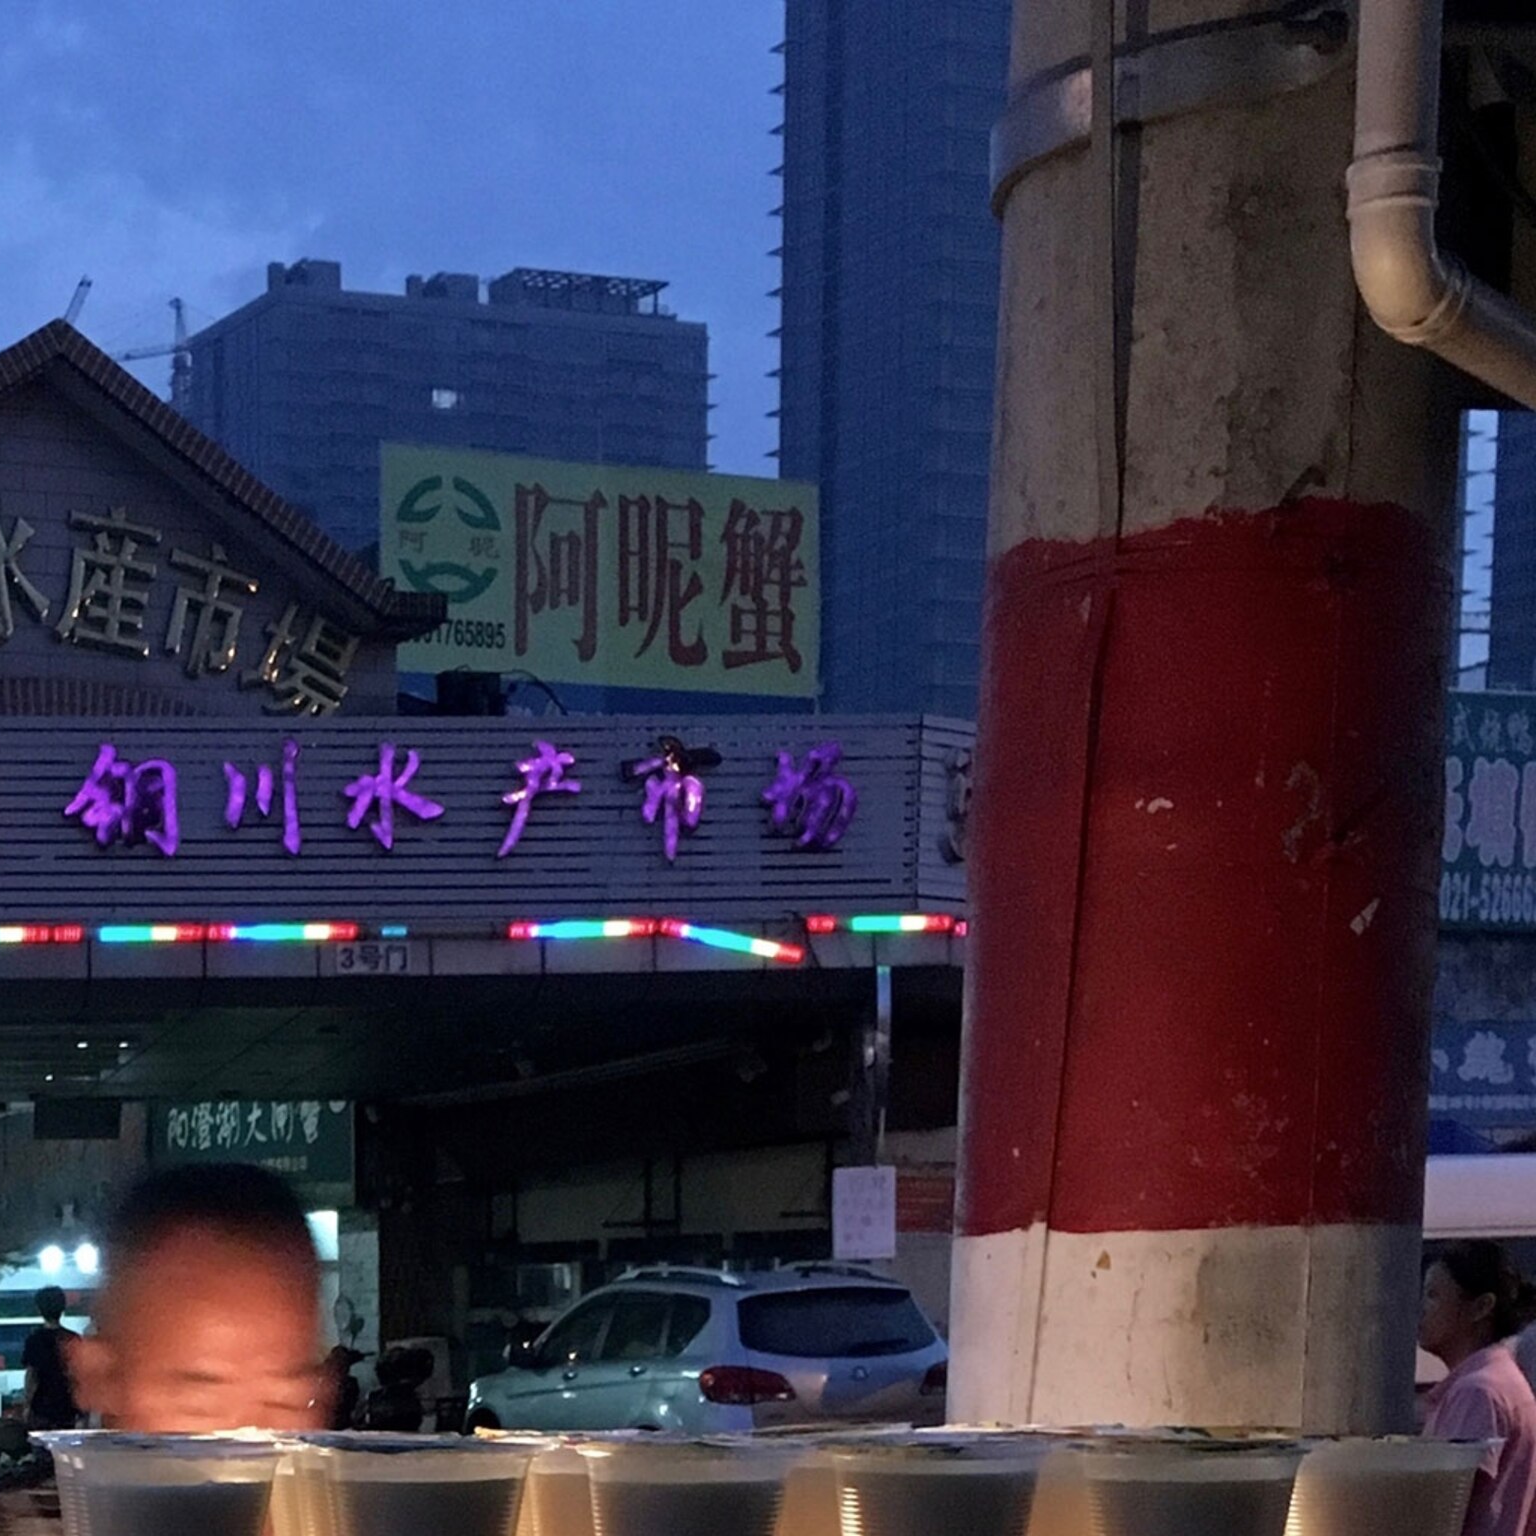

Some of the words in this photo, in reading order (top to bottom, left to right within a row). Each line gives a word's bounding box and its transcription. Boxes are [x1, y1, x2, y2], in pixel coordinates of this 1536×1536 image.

[514, 481, 807, 673] 阿昵蟹
[64, 737, 857, 861] 铜川水产市场
[339, 943, 408, 971] 3号门
[166, 1099, 321, 1151] 阳澄湖大闸蟹
